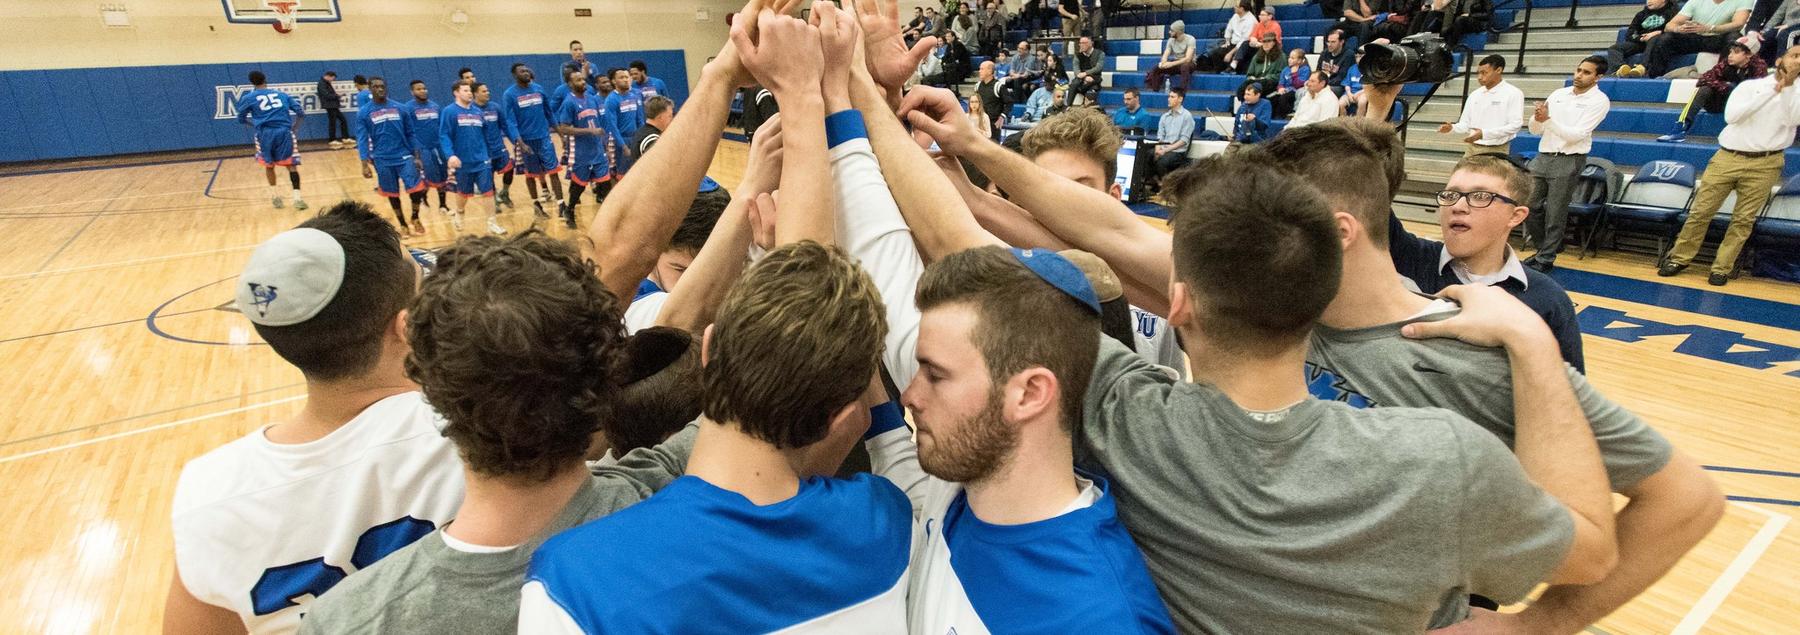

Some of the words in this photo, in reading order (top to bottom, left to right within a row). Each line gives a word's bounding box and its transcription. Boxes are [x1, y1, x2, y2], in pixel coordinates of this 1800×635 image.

[256, 93, 283, 110] 25
[1650, 160, 1685, 180] YU
[1135, 311, 1157, 339] YU
